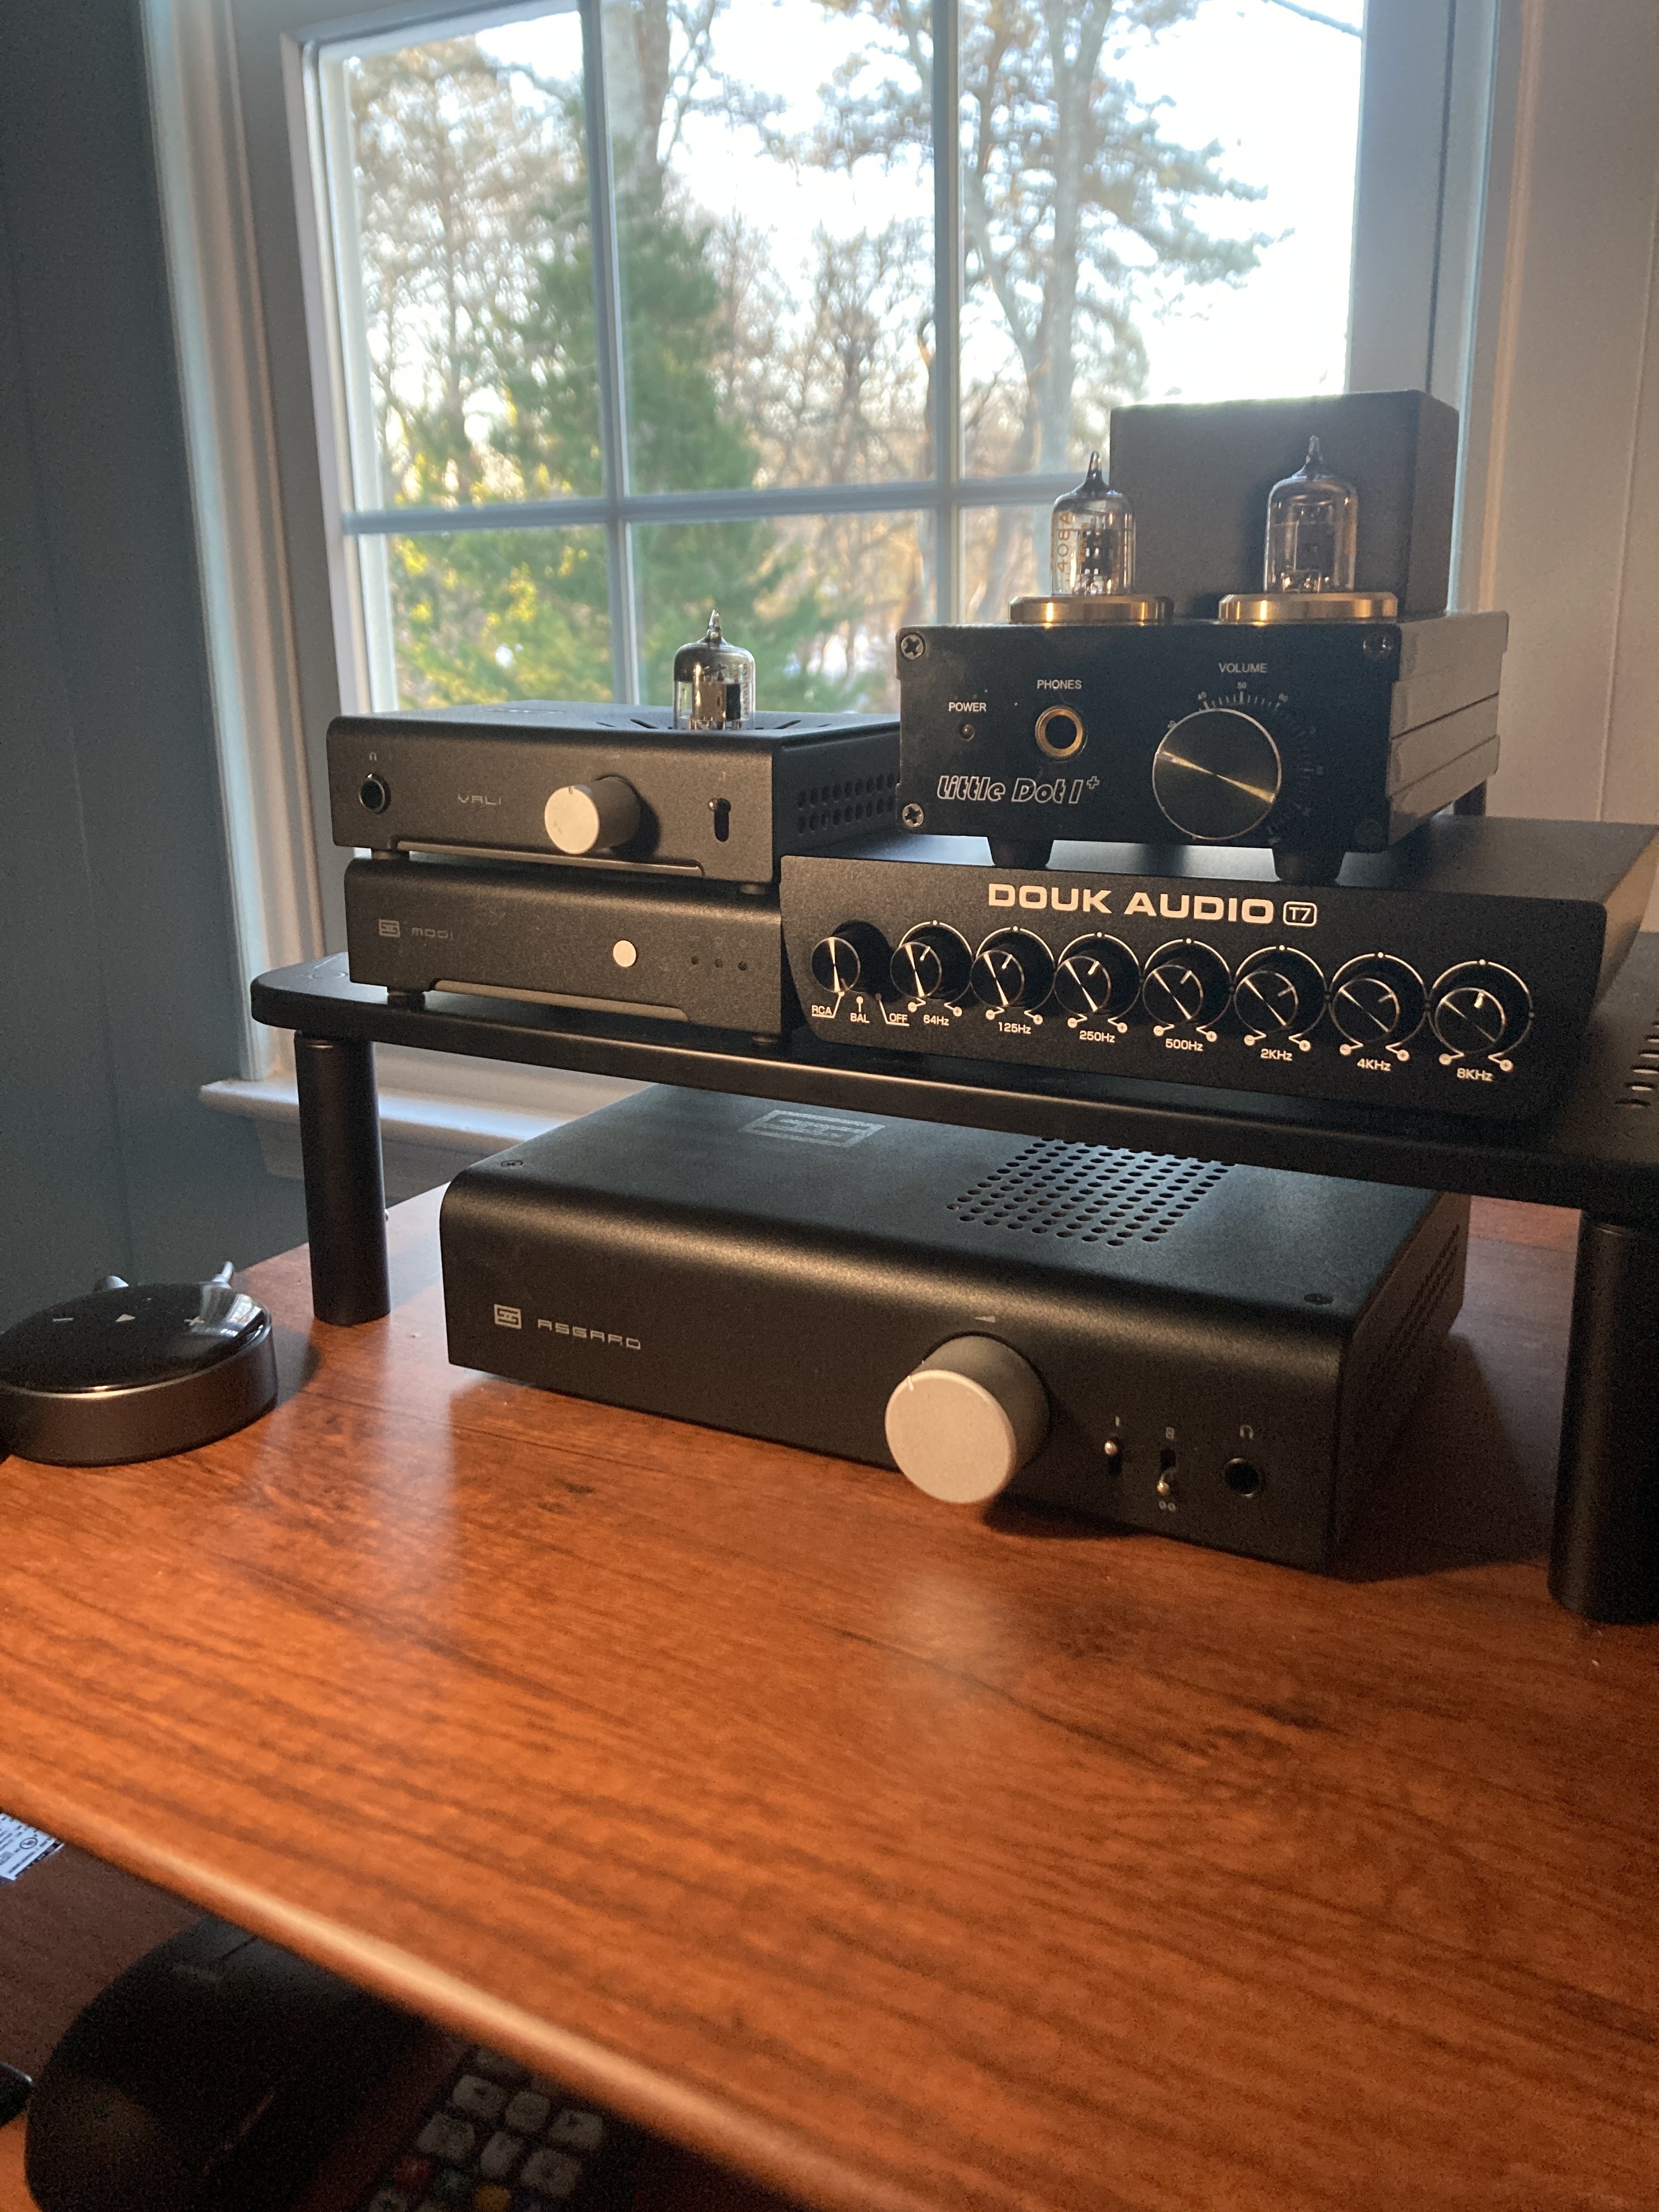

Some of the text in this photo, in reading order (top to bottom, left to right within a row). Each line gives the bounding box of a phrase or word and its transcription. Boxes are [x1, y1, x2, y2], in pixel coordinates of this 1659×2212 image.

[1057, 511, 1071, 573] 408A
[1218, 663, 1268, 674] VOLUME
[1037, 679, 1082, 690] PHONES
[1198, 691, 1206, 701] 40
[949, 702, 986, 712] POWER
[936, 775, 1006, 802] Little
[1011, 777, 1066, 804] Dot
[458, 794, 501, 805] VALI
[988, 883, 1311, 924] DOUK AUDIO T7
[811, 1005, 832, 1015] RCA
[850, 1013, 870, 1023] BAL
[889, 1013, 909, 1023] OFF
[923, 1014, 950, 1026] 64Hz
[998, 1022, 1031, 1034] 125Hz
[1079, 1030, 1115, 1043] 250Hz
[1165, 1038, 1204, 1052] 500Hz
[1261, 1048, 1293, 1061] 2KHz
[1357, 1058, 1391, 1072] 4KHz
[1457, 1068, 1493, 1082] 8KHz
[538, 1319, 641, 1350] ASGARD
